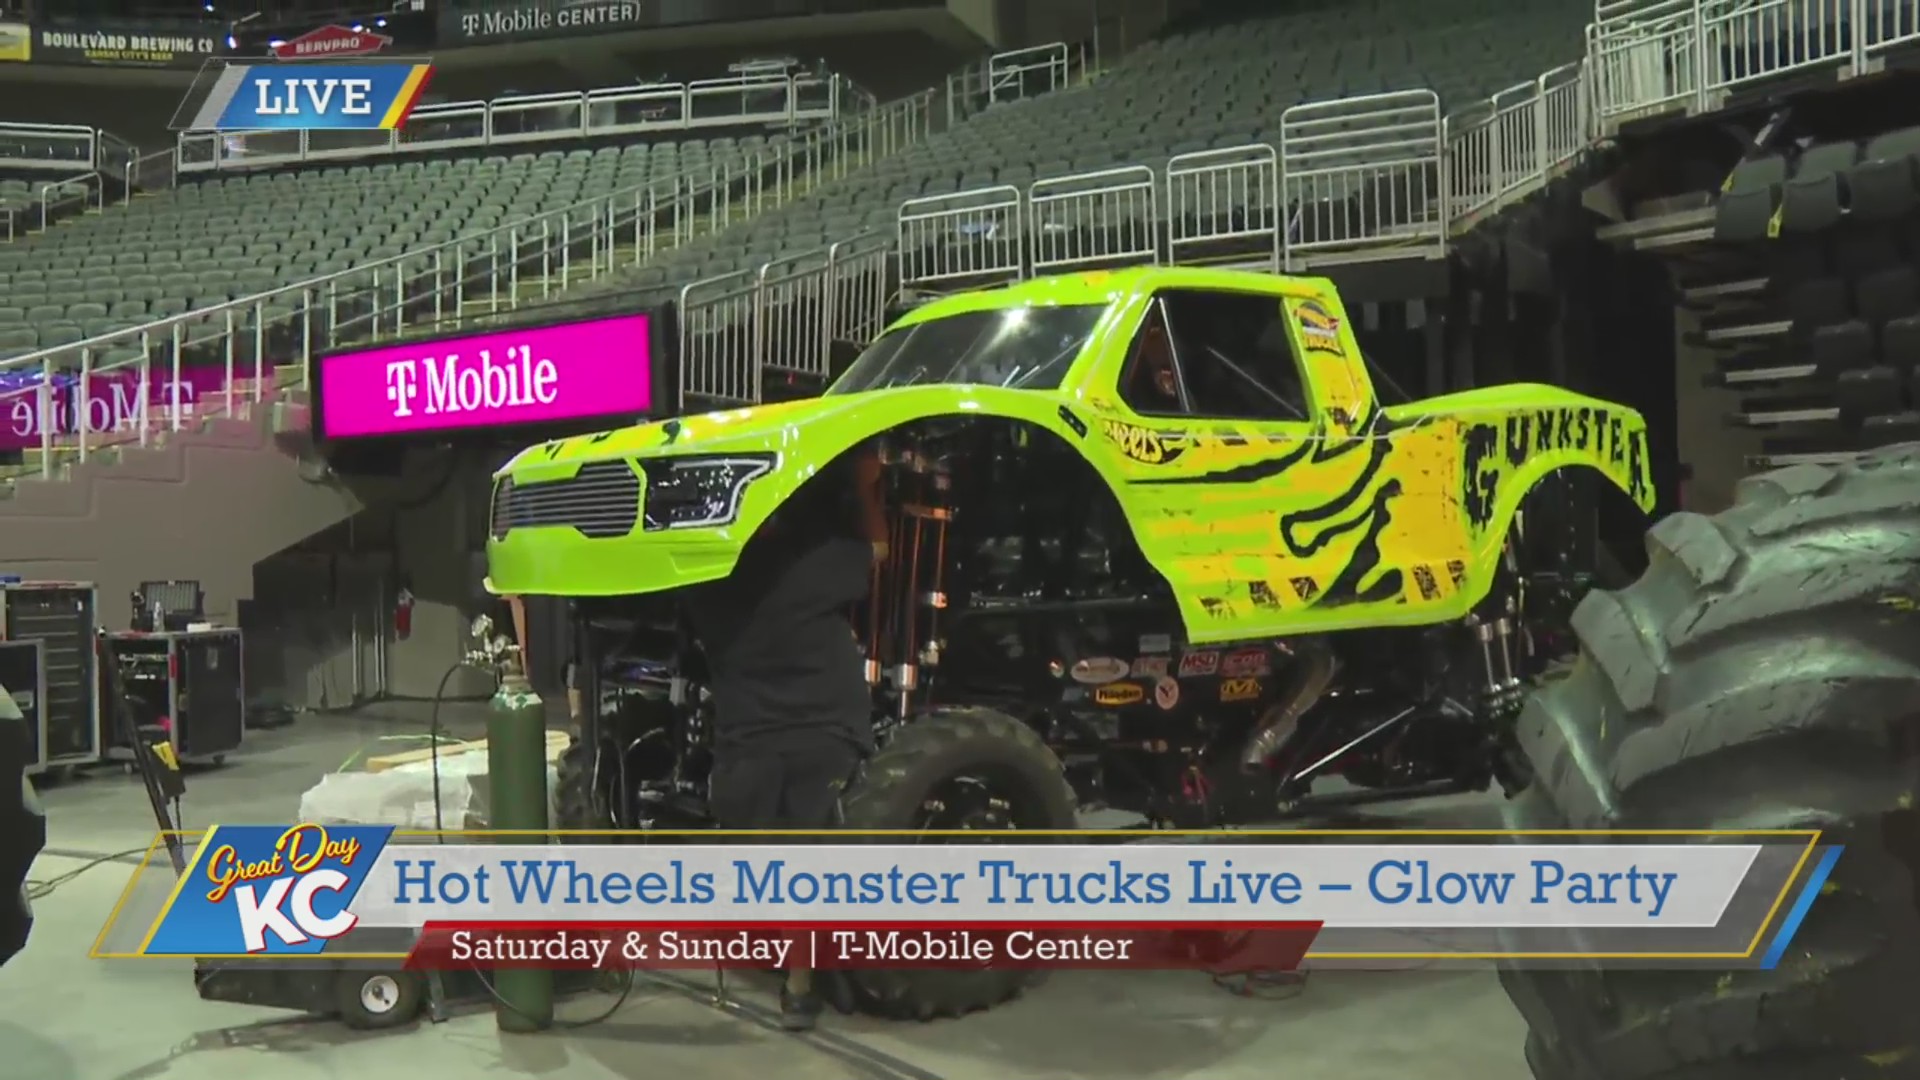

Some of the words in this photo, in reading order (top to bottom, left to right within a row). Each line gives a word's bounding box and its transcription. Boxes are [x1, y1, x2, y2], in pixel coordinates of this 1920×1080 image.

[483, 8, 552, 35] Mobile
[557, 4, 634, 27] CENTER
[42, 31, 127, 50] BOULEVARD
[131, 36, 194, 52] BREWING
[295, 36, 360, 54] SERVPRO
[422, 344, 558, 414] Mobile
